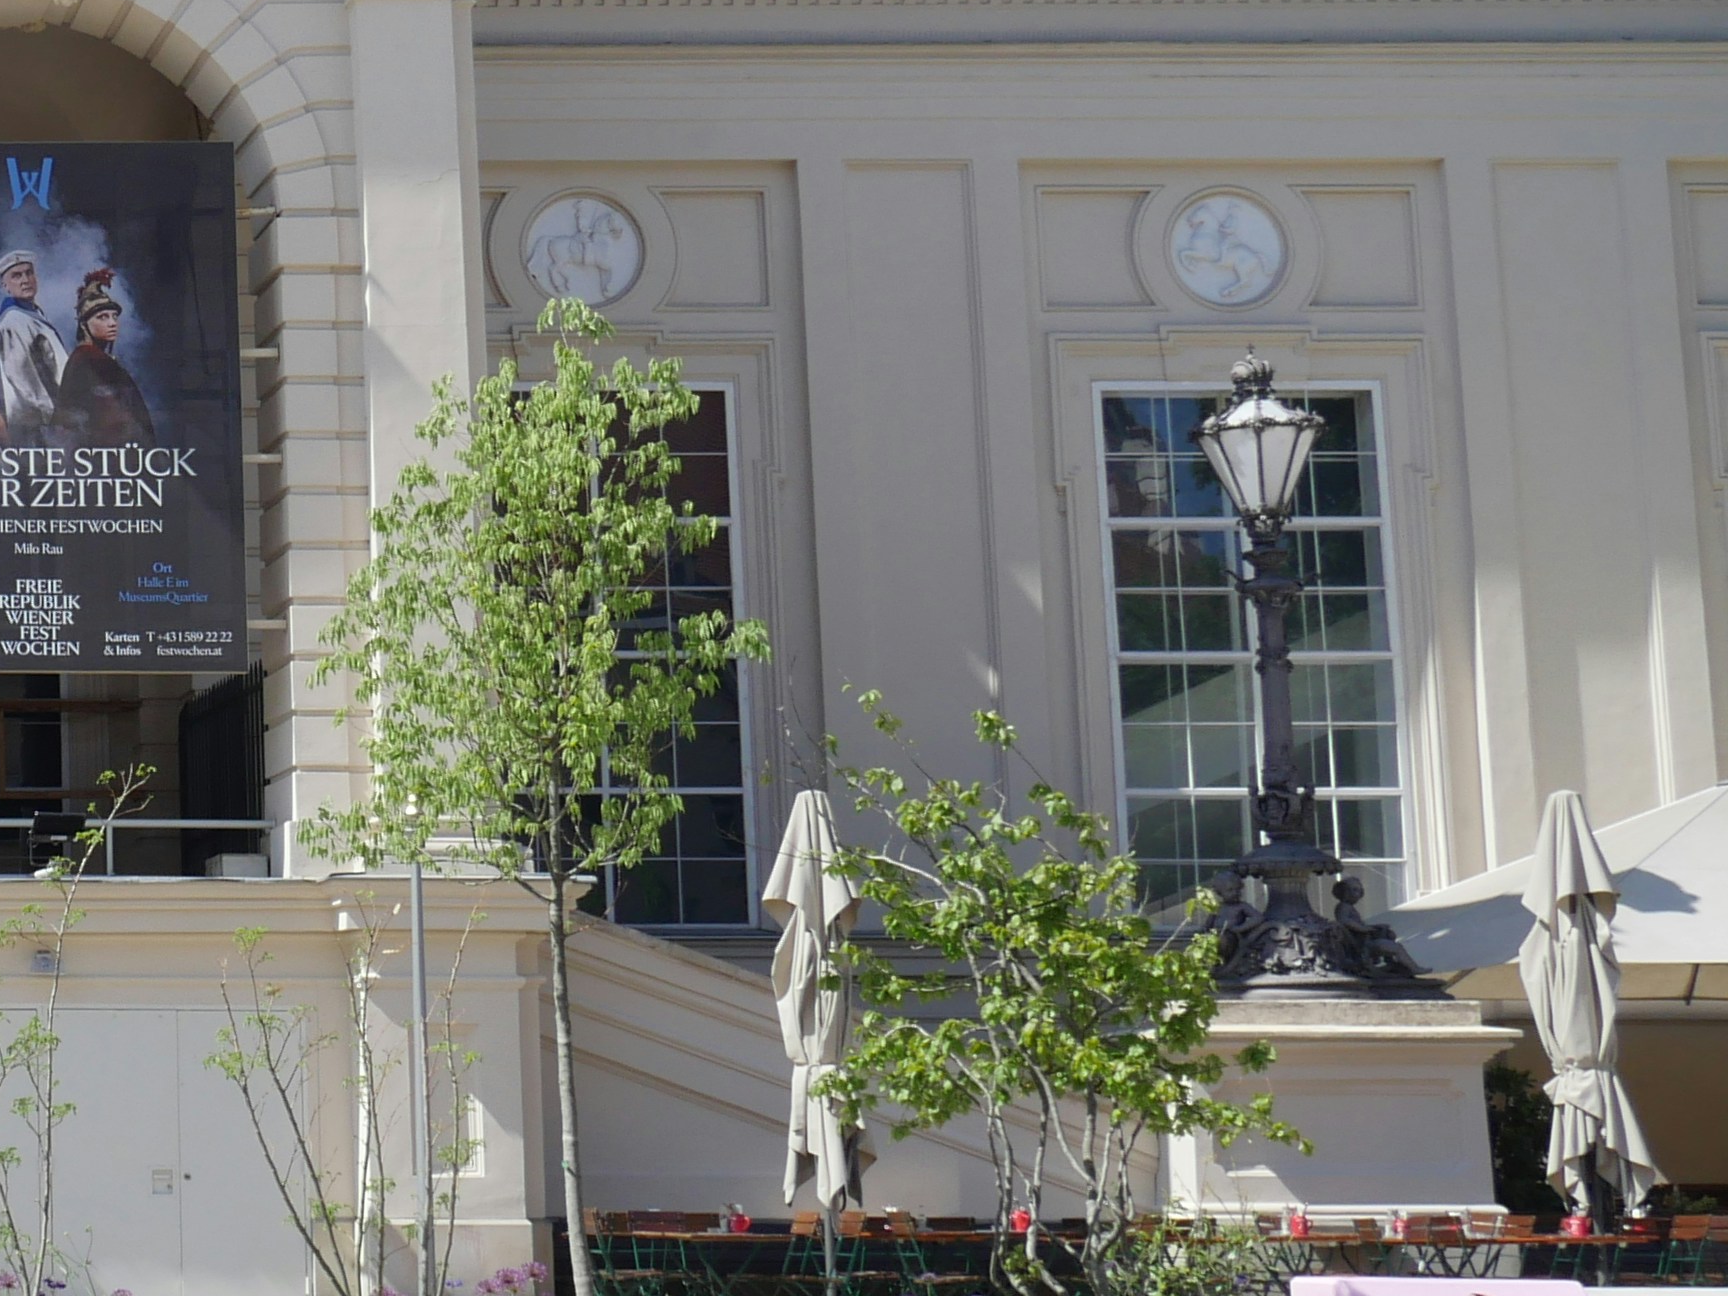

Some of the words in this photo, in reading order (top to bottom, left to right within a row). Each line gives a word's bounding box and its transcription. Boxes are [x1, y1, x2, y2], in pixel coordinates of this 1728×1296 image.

[74, 442, 197, 477] STÜCK
[30, 479, 164, 508] ZEITEN
[49, 519, 163, 534] FESTWOCHEN
[14, 542, 40, 555] Milo
[42, 542, 64, 555] Rau
[152, 562, 172, 574] Ort
[16, 579, 63, 594] FREIE
[137, 576, 164, 588] Halle
[166, 576, 175, 588] E
[176, 576, 189, 588] im
[118, 591, 209, 605] MuseumsQuartier
[5, 609, 75, 625] WIENER
[20, 625, 61, 640] FEST
[105, 631, 140, 643] Karten
[146, 631, 156, 643] T
[205, 631, 218, 642] 22
[220, 631, 233, 642] 22
[0, 641, 81, 656] WOCHEN
[103, 645, 114, 656] &
[116, 645, 142, 656] Infos
[156, 645, 223, 656] festwochen.at
